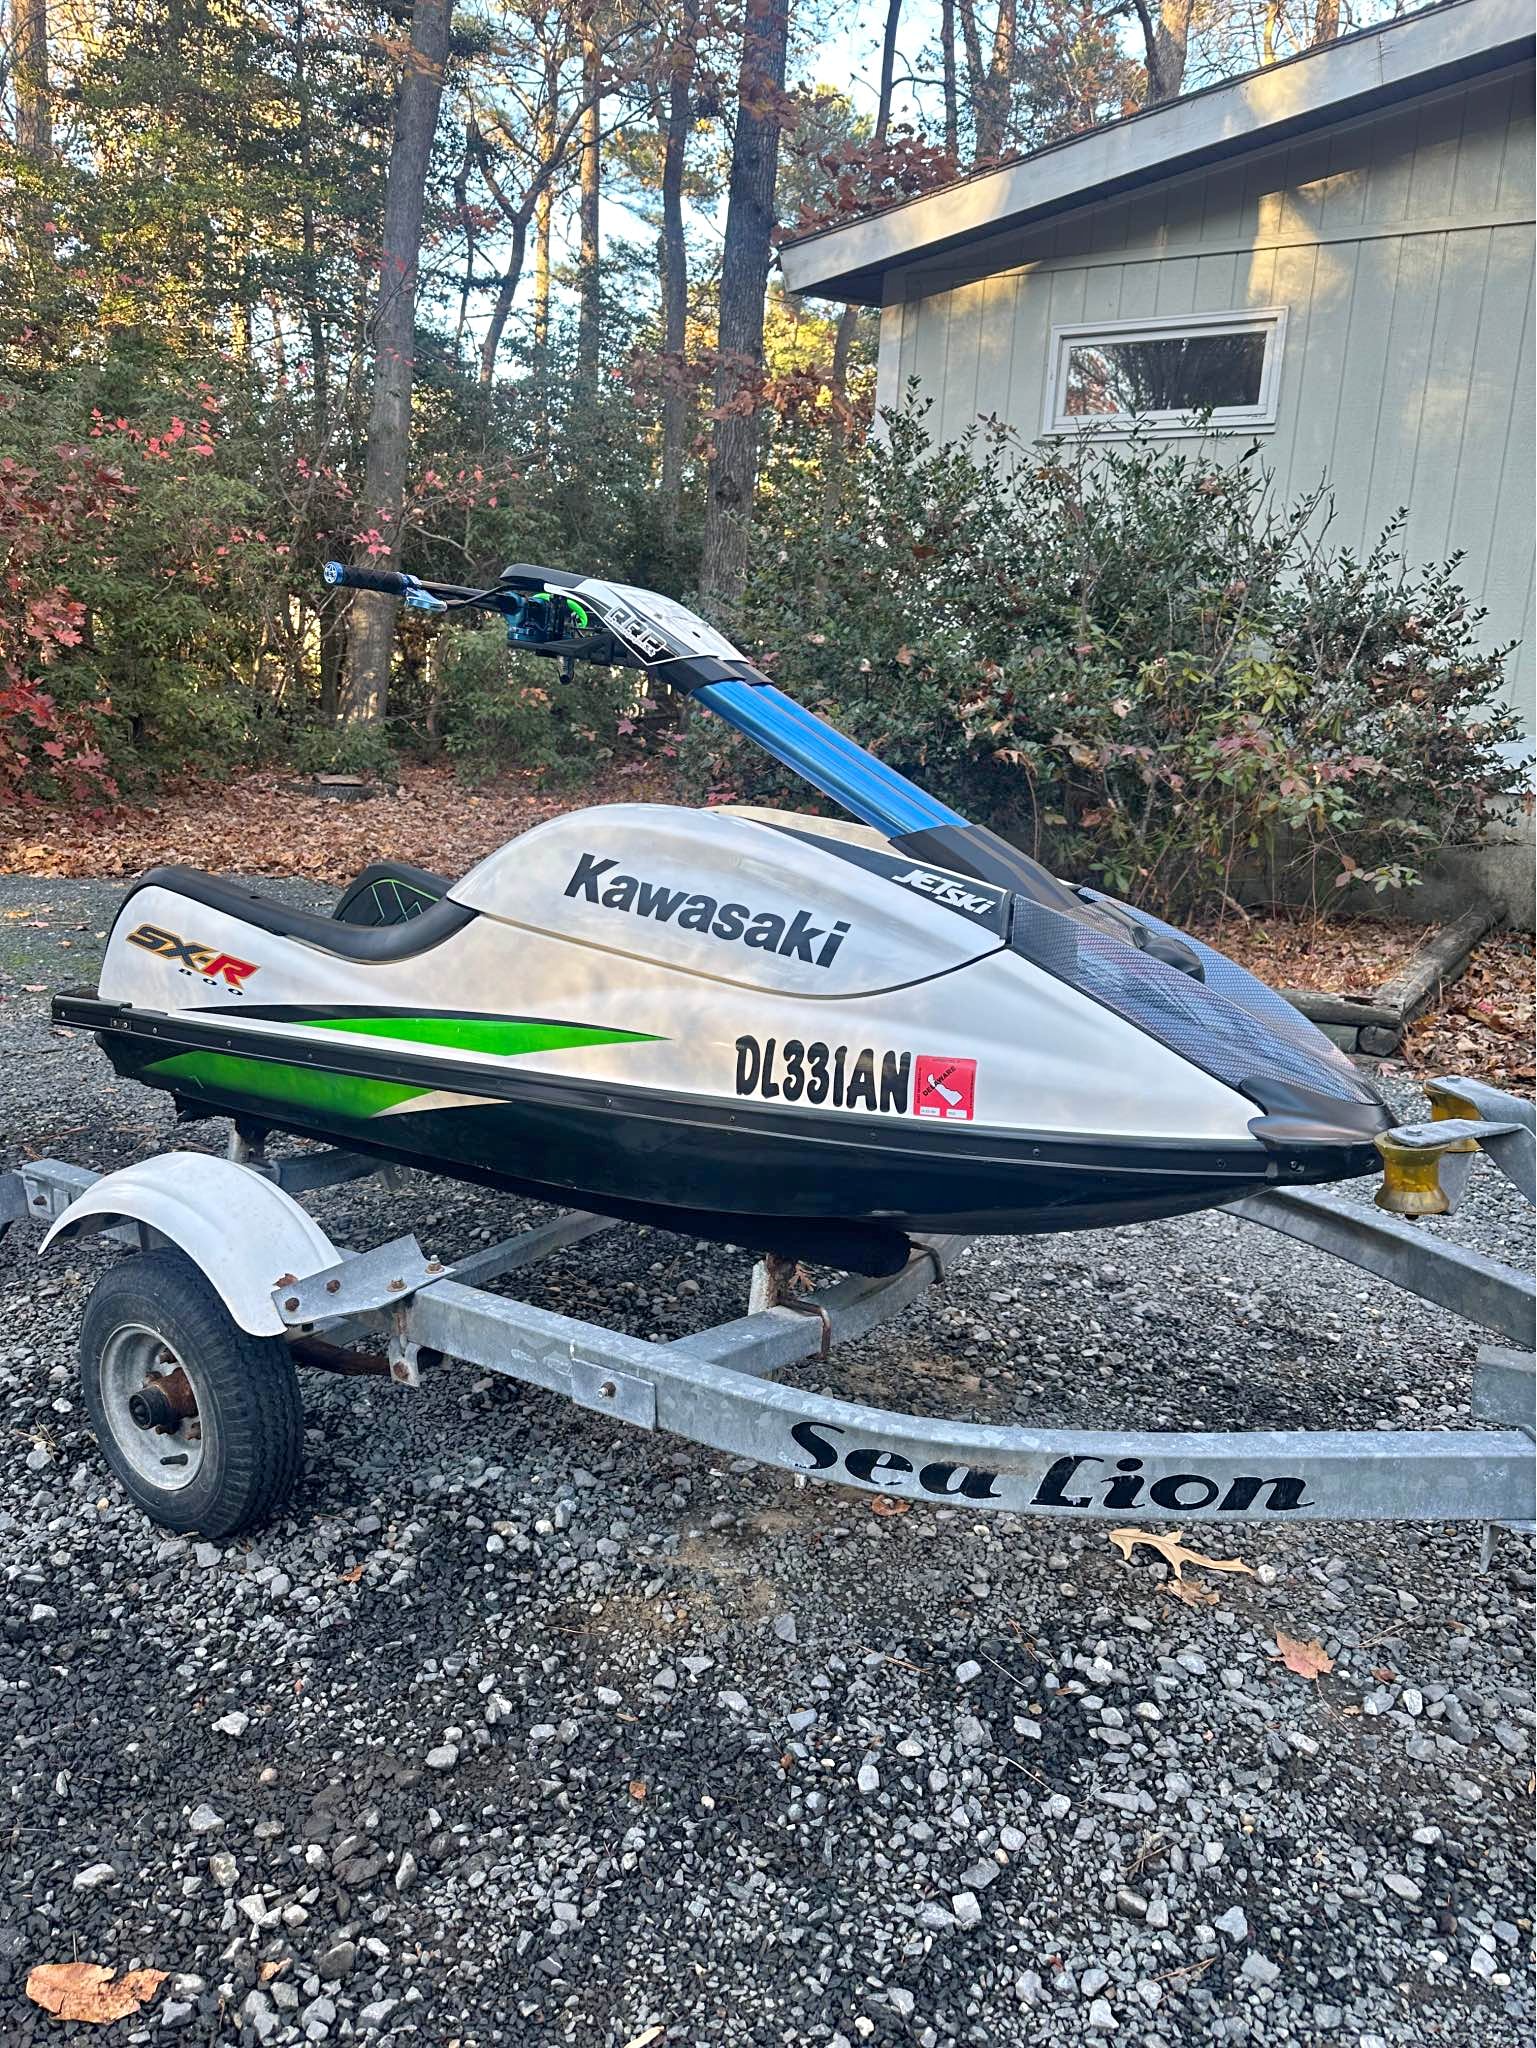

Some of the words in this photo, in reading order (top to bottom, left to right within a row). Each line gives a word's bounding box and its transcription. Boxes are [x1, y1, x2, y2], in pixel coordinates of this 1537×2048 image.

[563, 853, 852, 969] Kawasaki
[126, 923, 261, 990] SX-R
[735, 1035, 911, 1115] DL331AN
[922, 1065, 957, 1097] DELAWARE
[791, 1421, 1002, 1499] Sea
[1029, 1455, 1316, 1511] Lion
